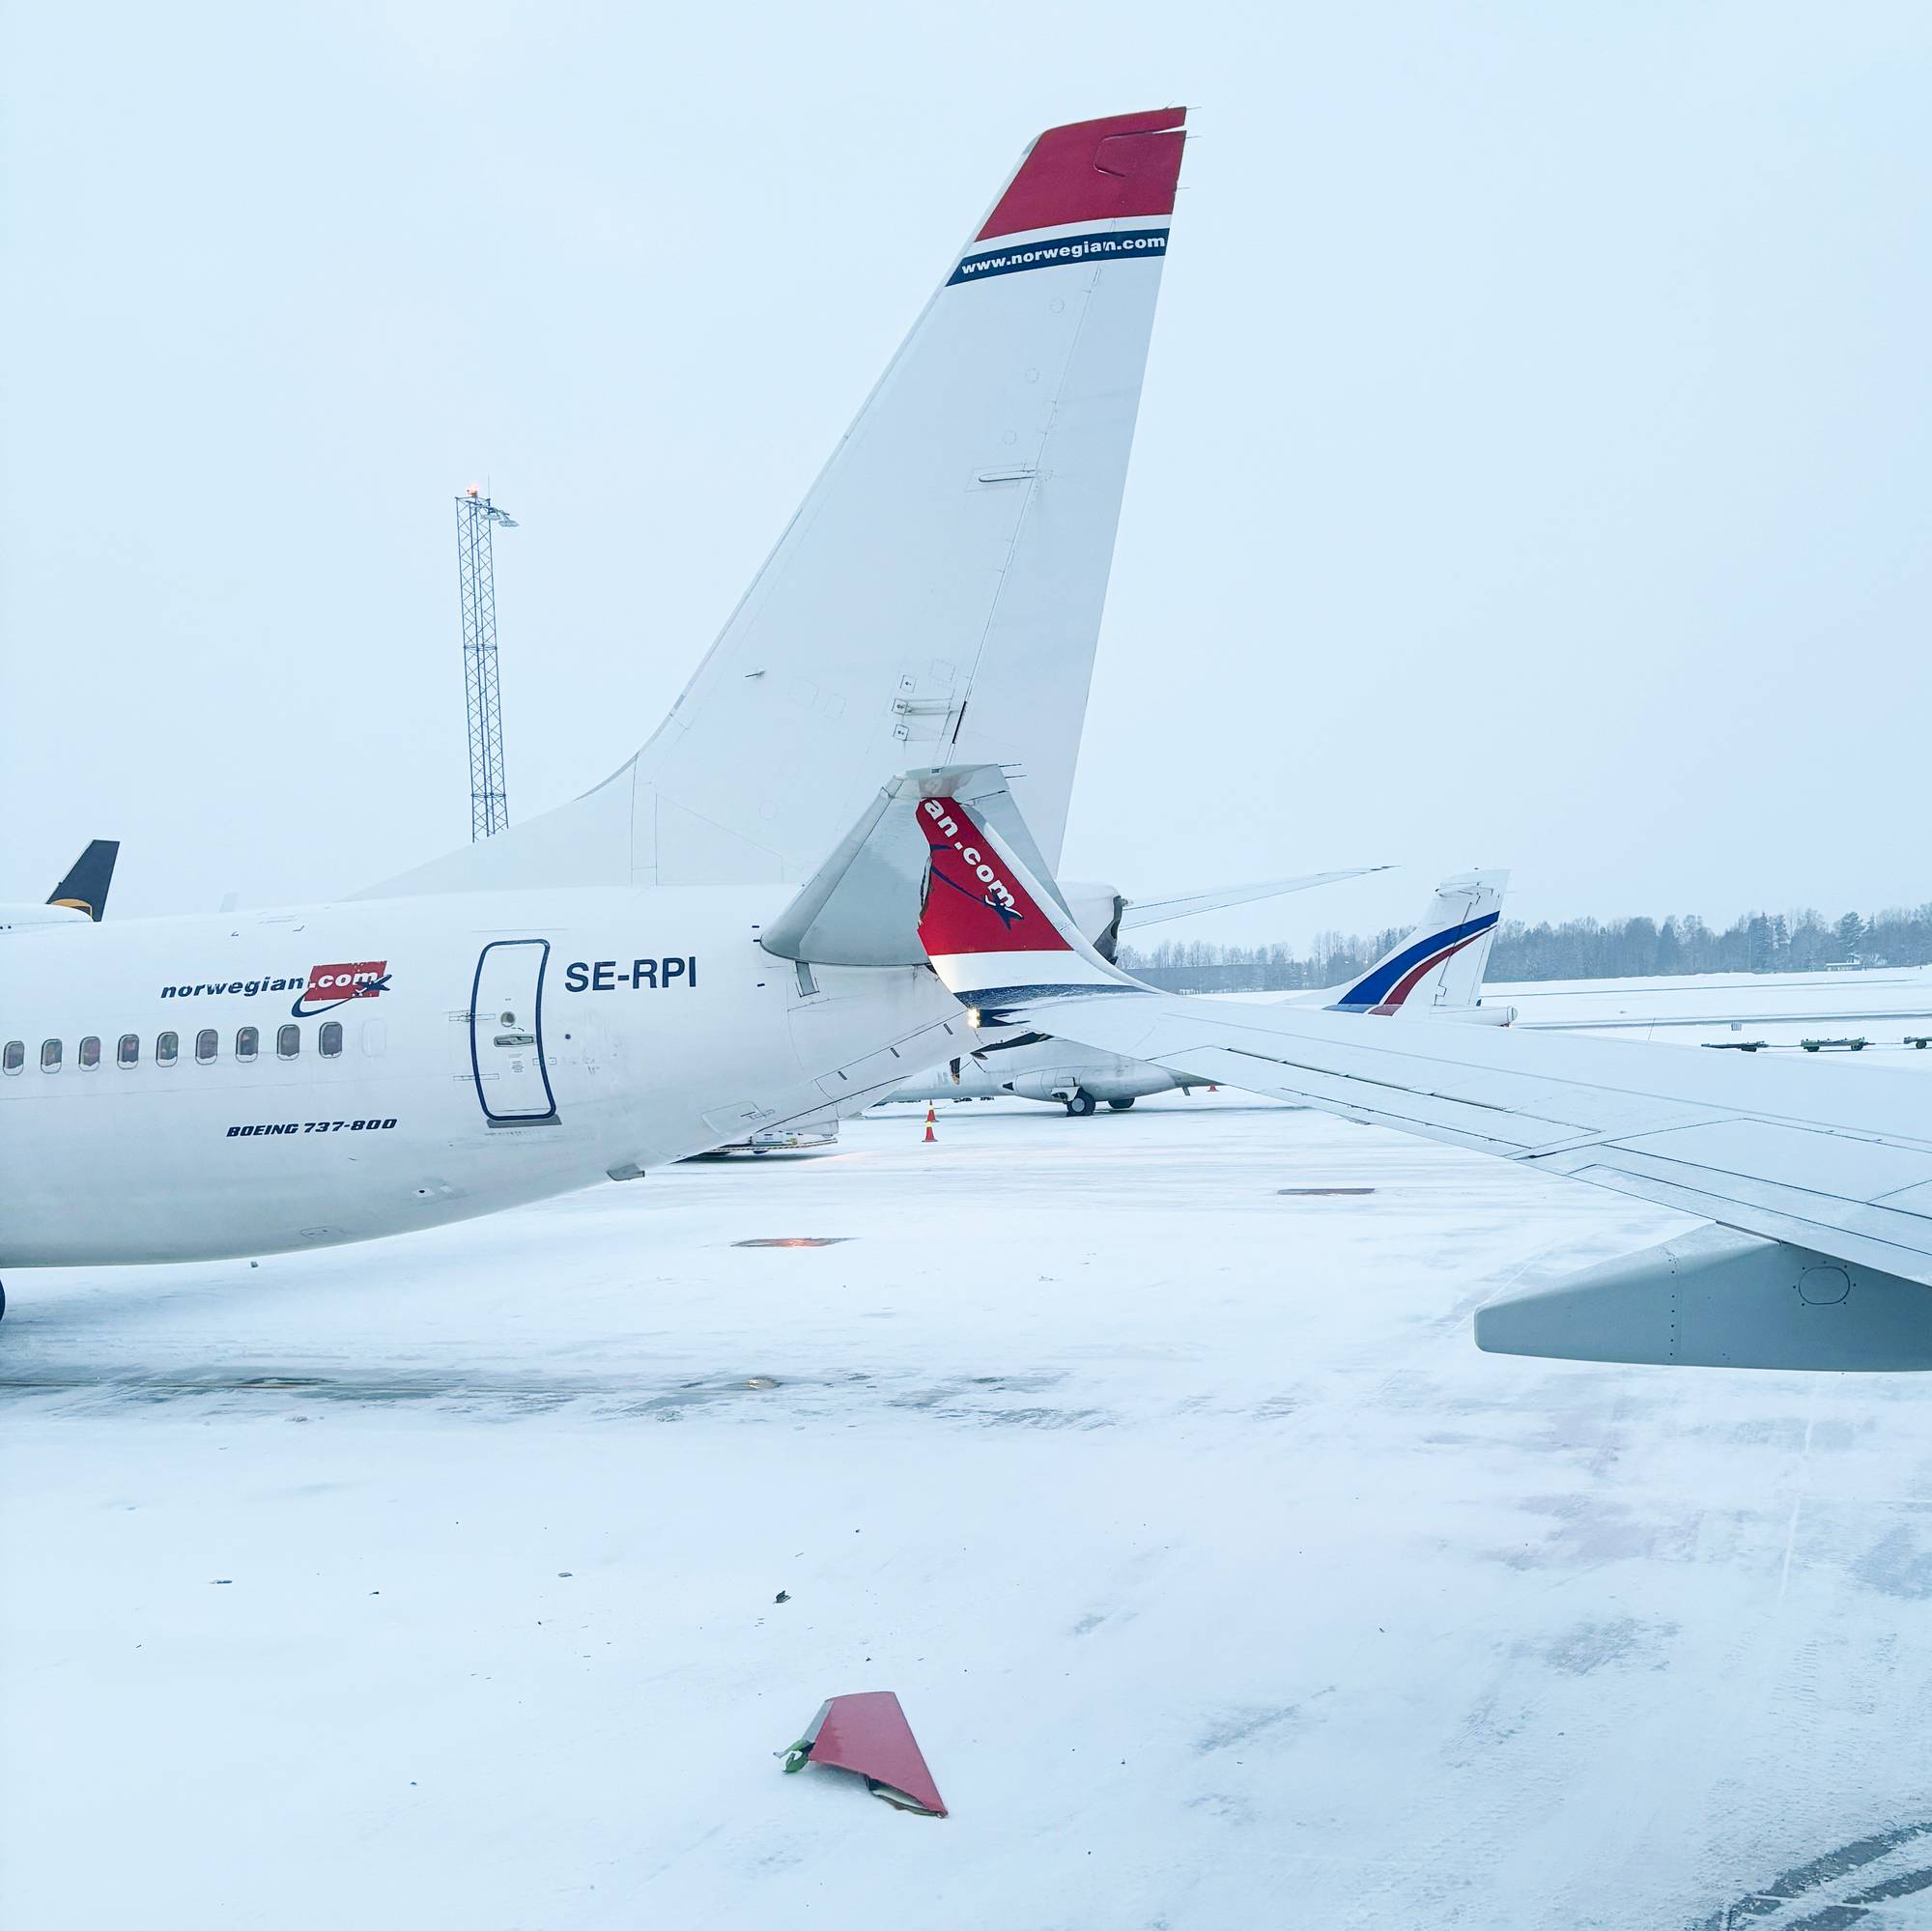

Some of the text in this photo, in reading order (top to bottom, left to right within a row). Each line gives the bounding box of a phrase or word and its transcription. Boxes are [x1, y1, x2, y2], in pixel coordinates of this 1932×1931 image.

[961, 236, 1166, 274] www.norwegian.com
[160, 972, 379, 998] norwegian.com
[564, 956, 696, 992] SE-RPI
[226, 1119, 398, 1138] BOEING 737-800
